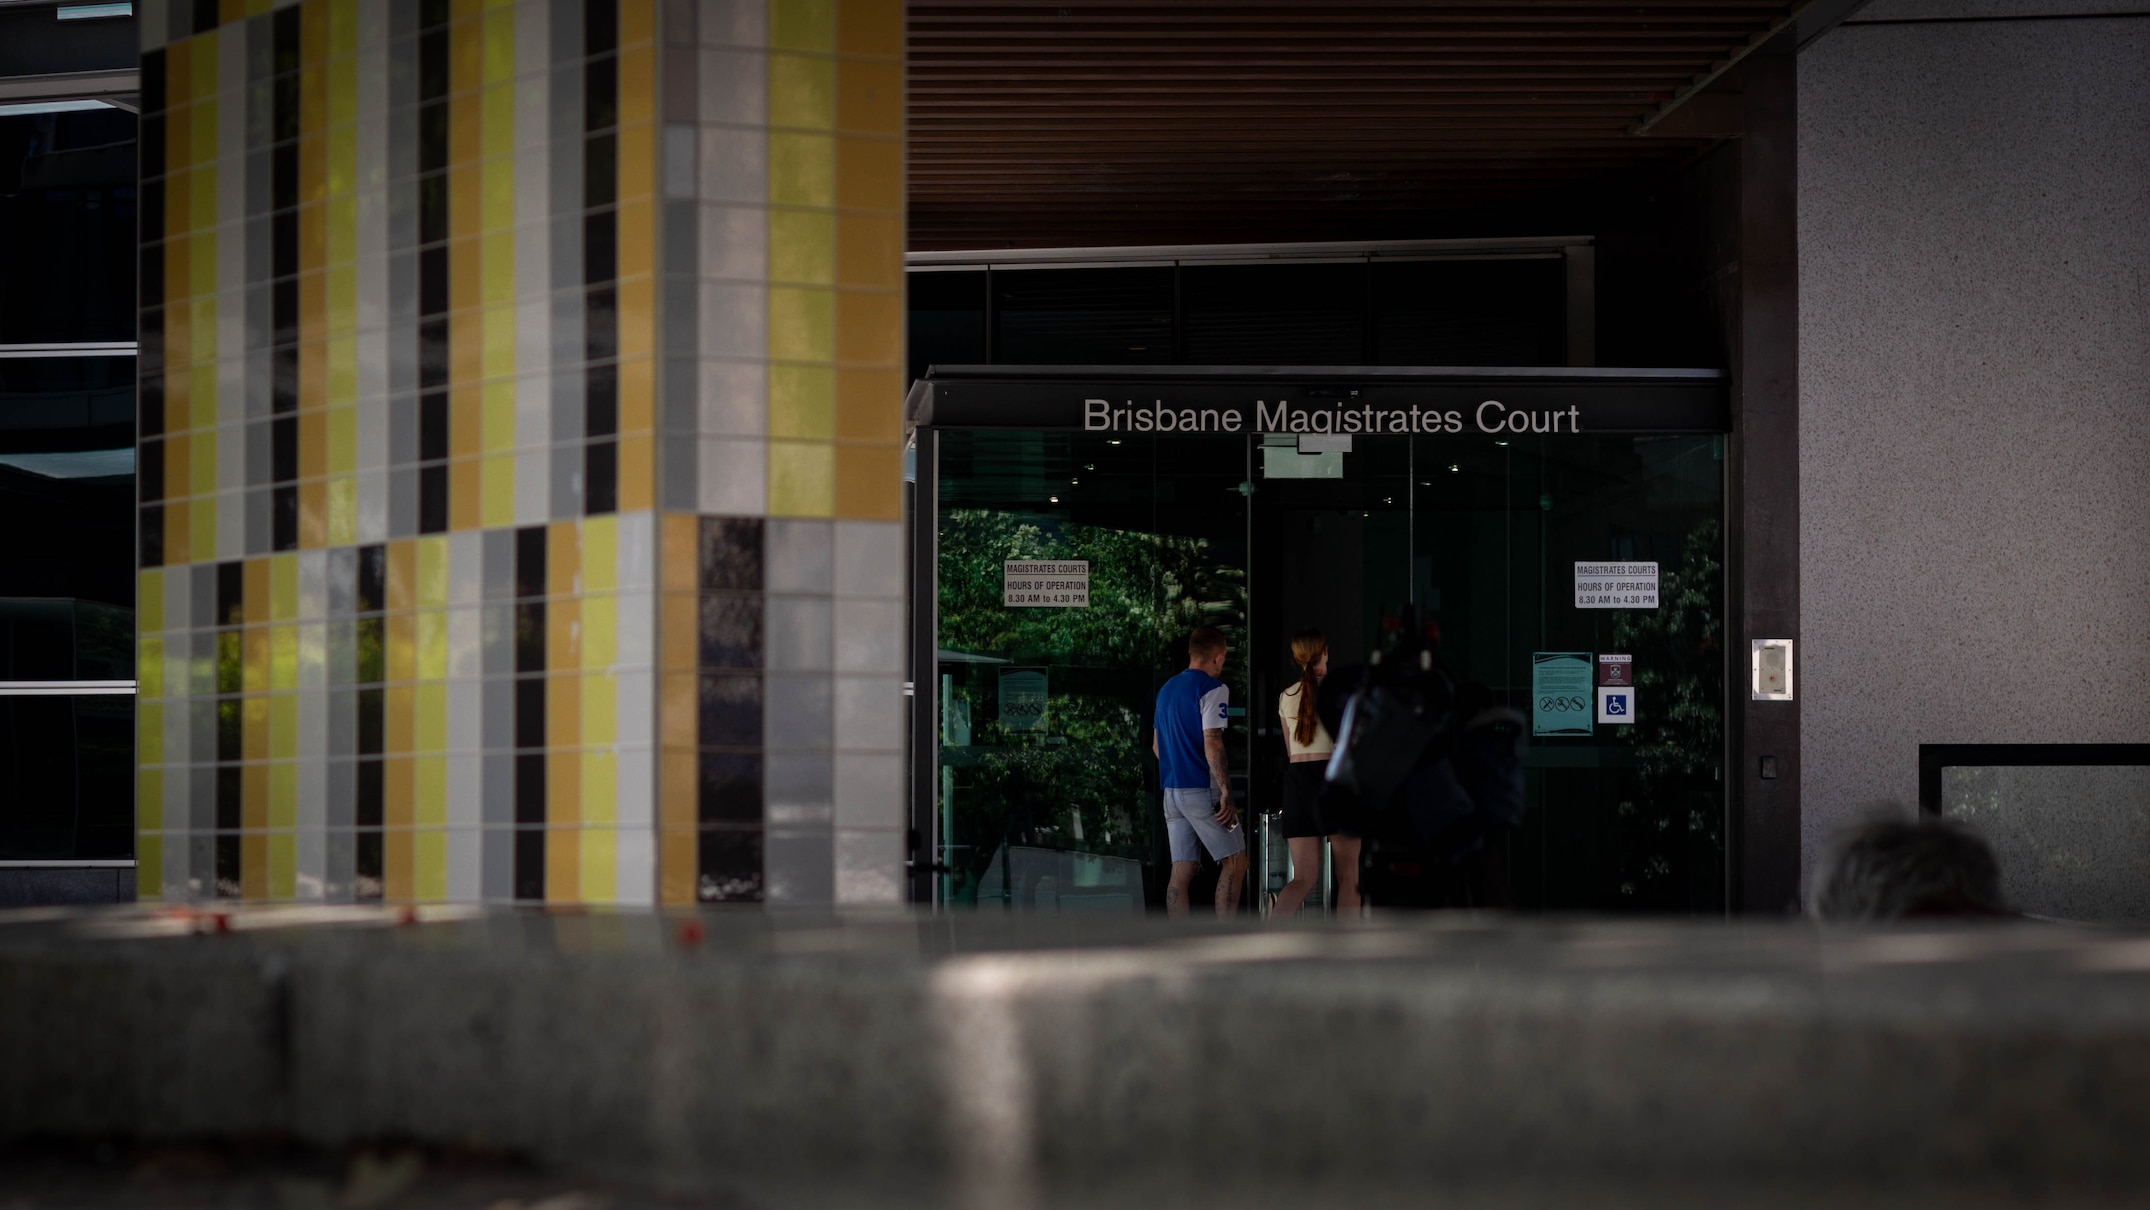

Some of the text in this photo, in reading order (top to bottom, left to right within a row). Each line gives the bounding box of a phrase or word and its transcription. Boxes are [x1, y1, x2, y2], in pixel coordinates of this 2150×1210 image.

[1084, 399, 1580, 441] Brisbane Magistrates Court
[1007, 564, 1087, 573] MAGISTRATES COURTS
[1577, 565, 1656, 575] MAGISTRATES COURTS
[1007, 581, 1086, 590] HOURS OF OPERATION
[1577, 582, 1656, 591] HOURS OF OPERATION
[1008, 594, 1085, 603] 8.30 AM to 4.30 PM
[1579, 596, 1655, 604] 8.30 AM to 4.30 PM
[1218, 702, 1228, 719] 3
